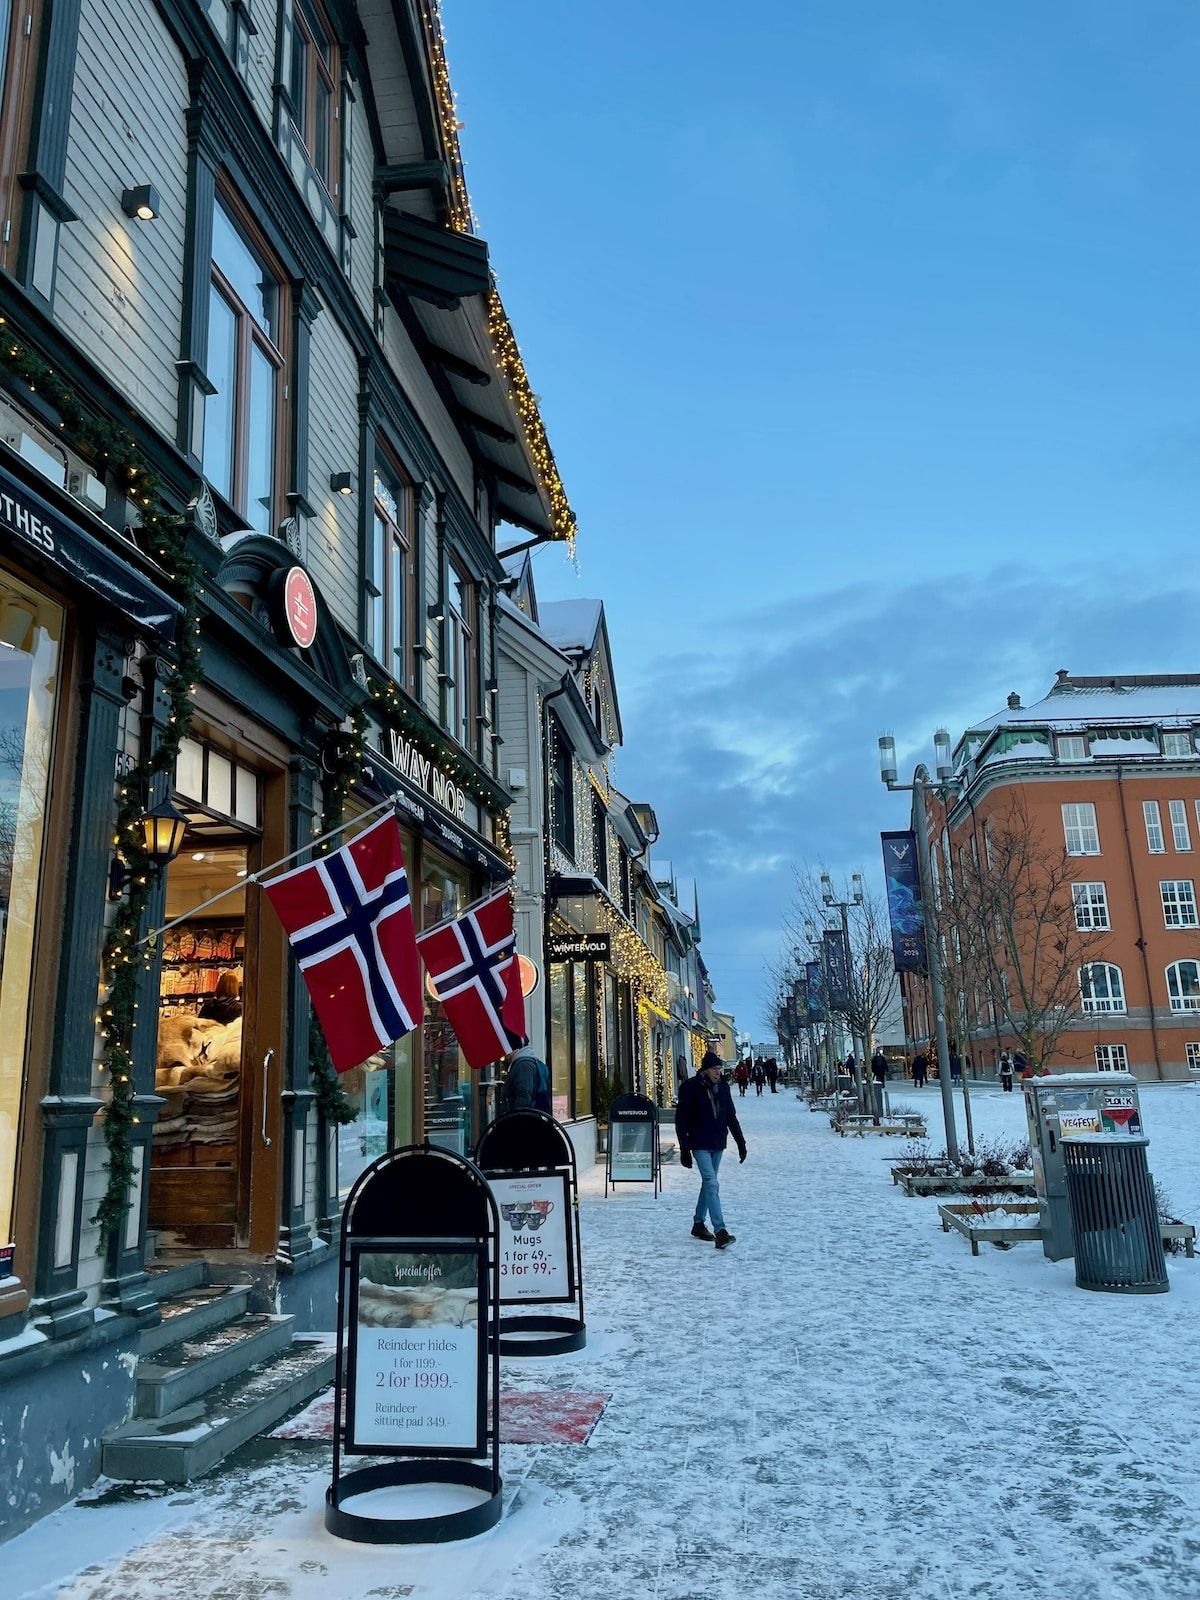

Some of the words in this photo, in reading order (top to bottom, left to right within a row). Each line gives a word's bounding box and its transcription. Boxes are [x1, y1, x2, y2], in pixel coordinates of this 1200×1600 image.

[0, 492, 55, 551] THES
[390, 728, 430, 793] WAY
[433, 767, 466, 823] NOR
[552, 942, 607, 953] WINTERVOLD
[1062, 1117, 1096, 1128] VEGFEST
[513, 1235, 542, 1247] Mugs
[504, 1252, 509, 1261] 1
[513, 1252, 529, 1261] for
[394, 1264, 422, 1280] Special
[423, 1264, 443, 1281] offer
[501, 1264, 508, 1276] 3
[511, 1264, 529, 1275] for
[377, 1338, 425, 1351] Reindeer
[428, 1338, 457, 1351] hides
[399, 1357, 414, 1368] for
[376, 1372, 385, 1387] 2
[389, 1371, 410, 1387] for
[414, 1372, 459, 1389] 1999.-
[375, 1402, 418, 1413] Reindeer
[374, 1416, 404, 1428] sitting
[406, 1416, 424, 1428] pad
